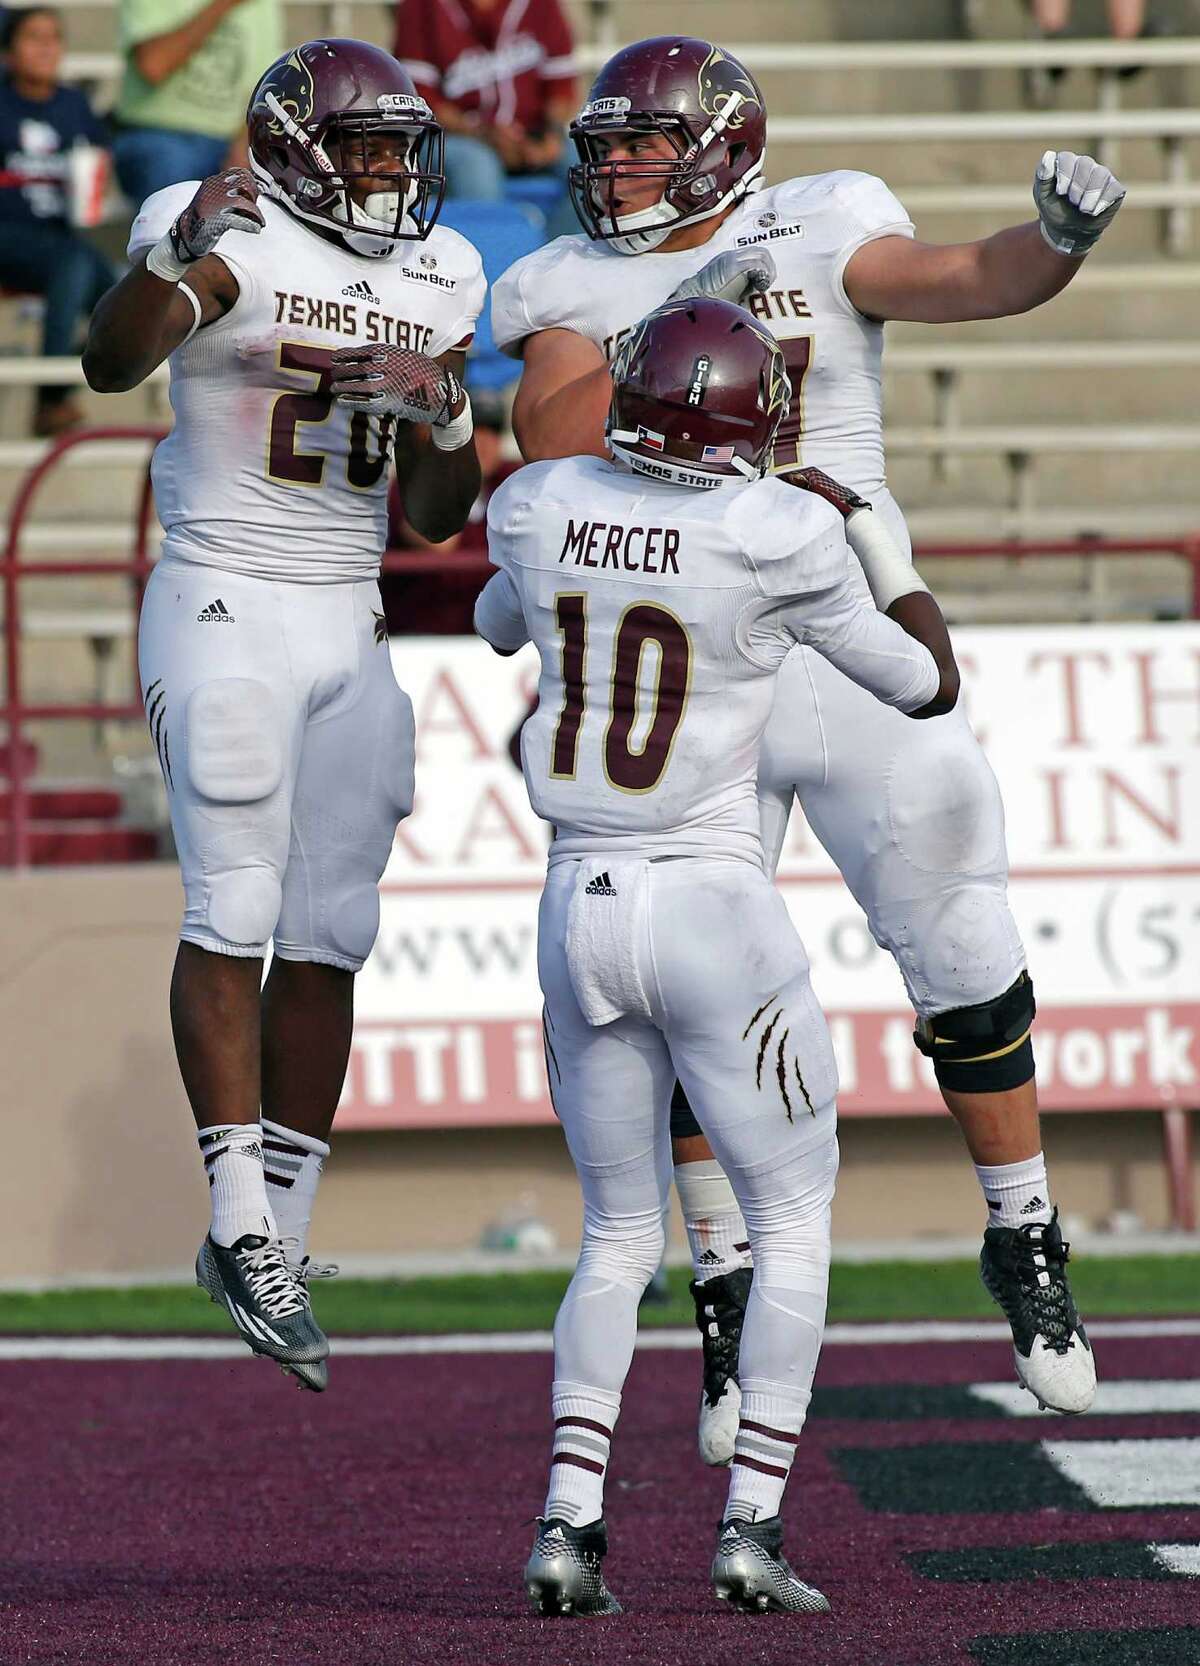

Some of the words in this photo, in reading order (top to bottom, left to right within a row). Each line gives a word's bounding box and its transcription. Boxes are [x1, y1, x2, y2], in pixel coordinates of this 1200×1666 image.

[392, 95, 416, 107] CATS
[593, 100, 616, 111] CATS
[768, 223, 802, 239] BELT
[429, 273, 456, 289] BELT
[341, 288, 381, 305] adidas
[274, 291, 357, 336] TEXAS
[688, 360, 710, 405] GISH
[266, 338, 397, 493] 20
[628, 455, 673, 480] TEXAS
[678, 472, 724, 488] STATE
[558, 519, 681, 575] MERCER
[197, 612, 236, 624] adidas
[548, 591, 694, 796] 10
[585, 886, 618, 897] adidas
